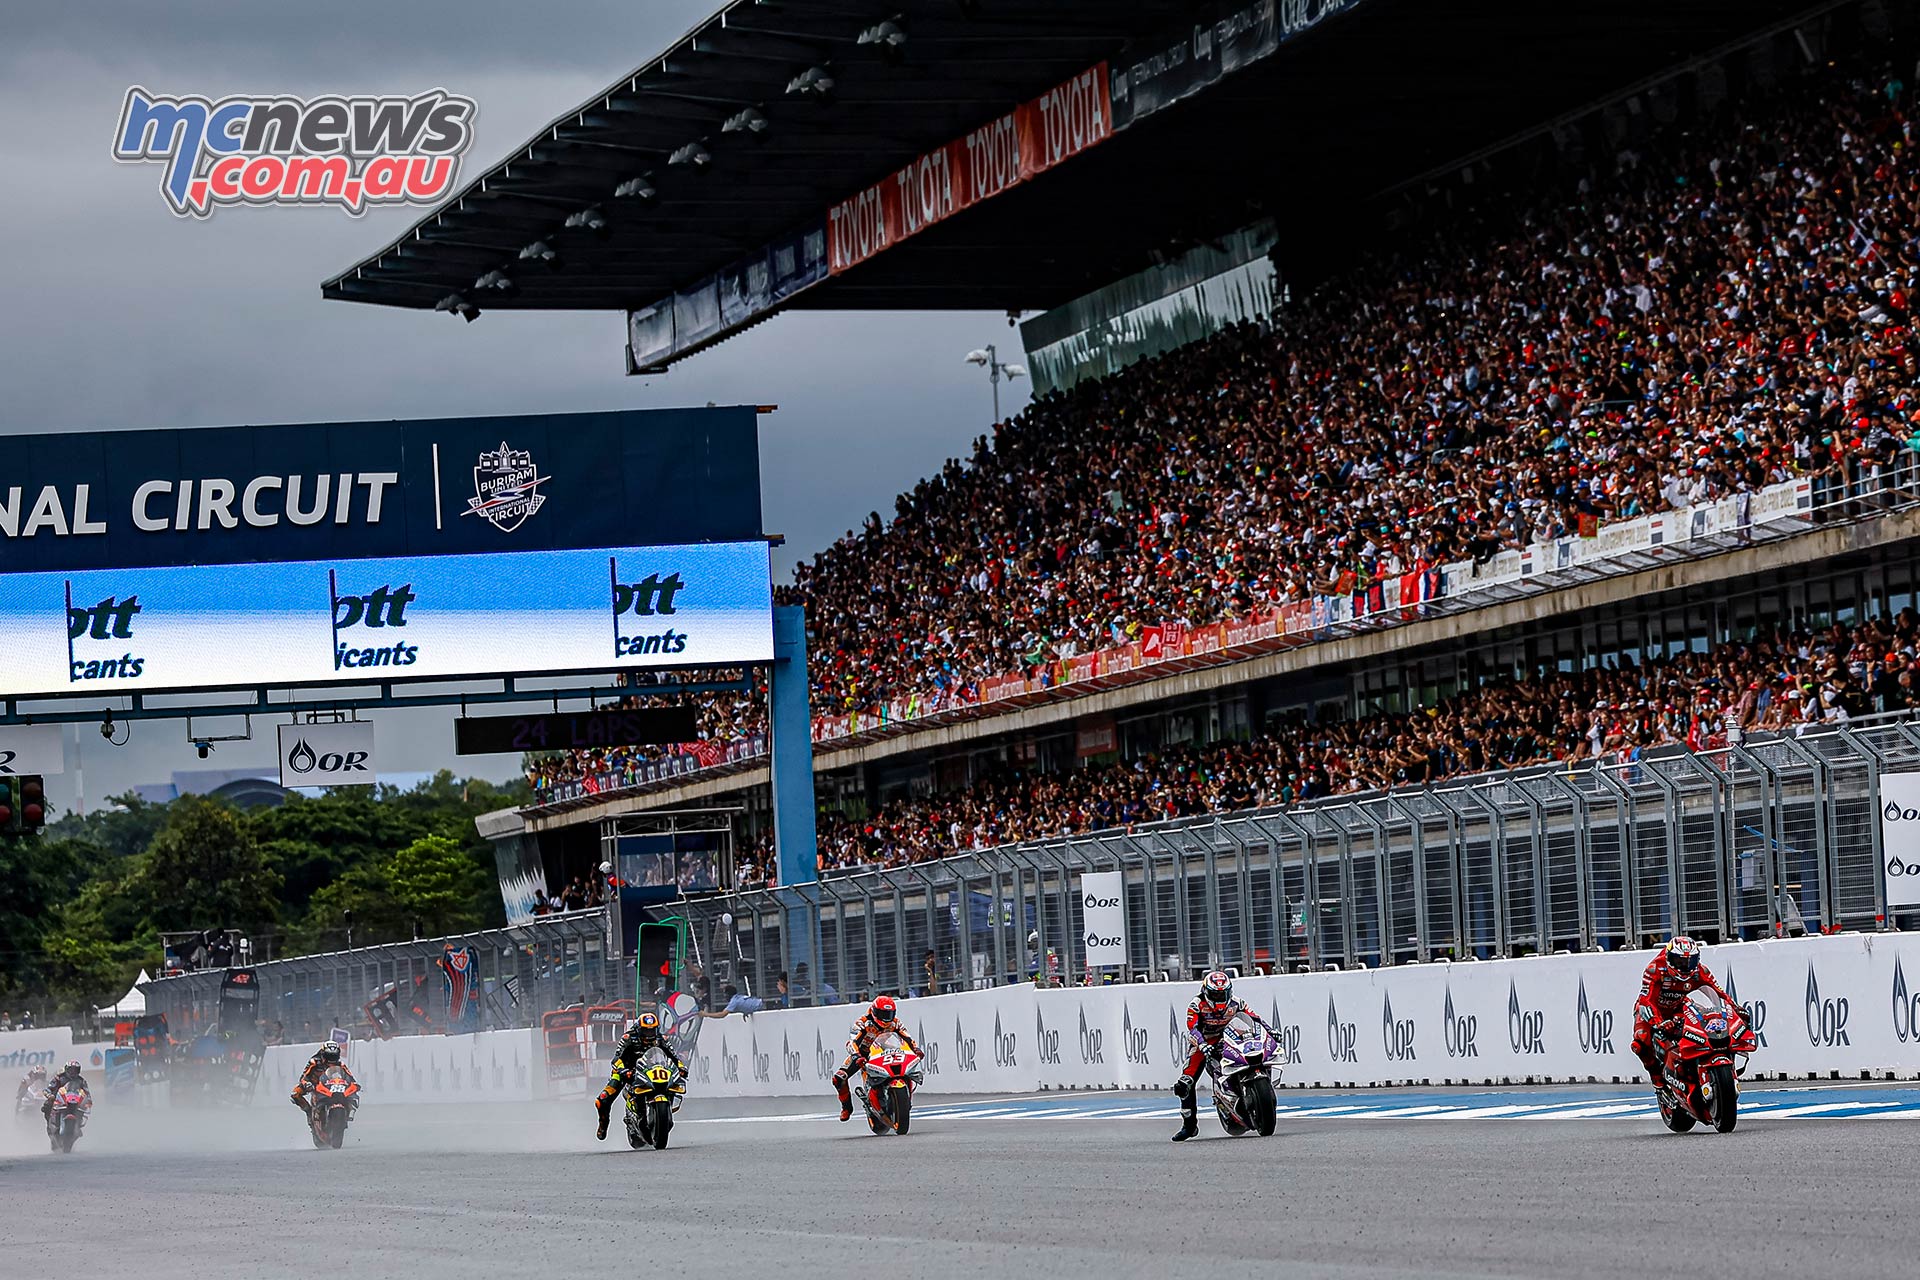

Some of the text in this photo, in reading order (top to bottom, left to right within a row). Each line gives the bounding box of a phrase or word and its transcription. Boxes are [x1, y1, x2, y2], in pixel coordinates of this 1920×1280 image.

[1040, 69, 1105, 166] TOYOTA
[967, 111, 1021, 201] TOYOTA
[897, 147, 953, 235] TOYOTA
[830, 184, 886, 269] TOYOTA
[480, 467, 533, 493] BURIRAM
[131, 471, 398, 531] CIRCUIT
[488, 503, 531, 523] CIRCUIT
[512, 713, 642, 749] 24 LAPS
[317, 751, 370, 773] OR
[1684, 1031, 1706, 1044] Lenovo
[882, 1054, 906, 1066] 93
[651, 1069, 669, 1081] 10
[1664, 1070, 1686, 1092] Lenovo
